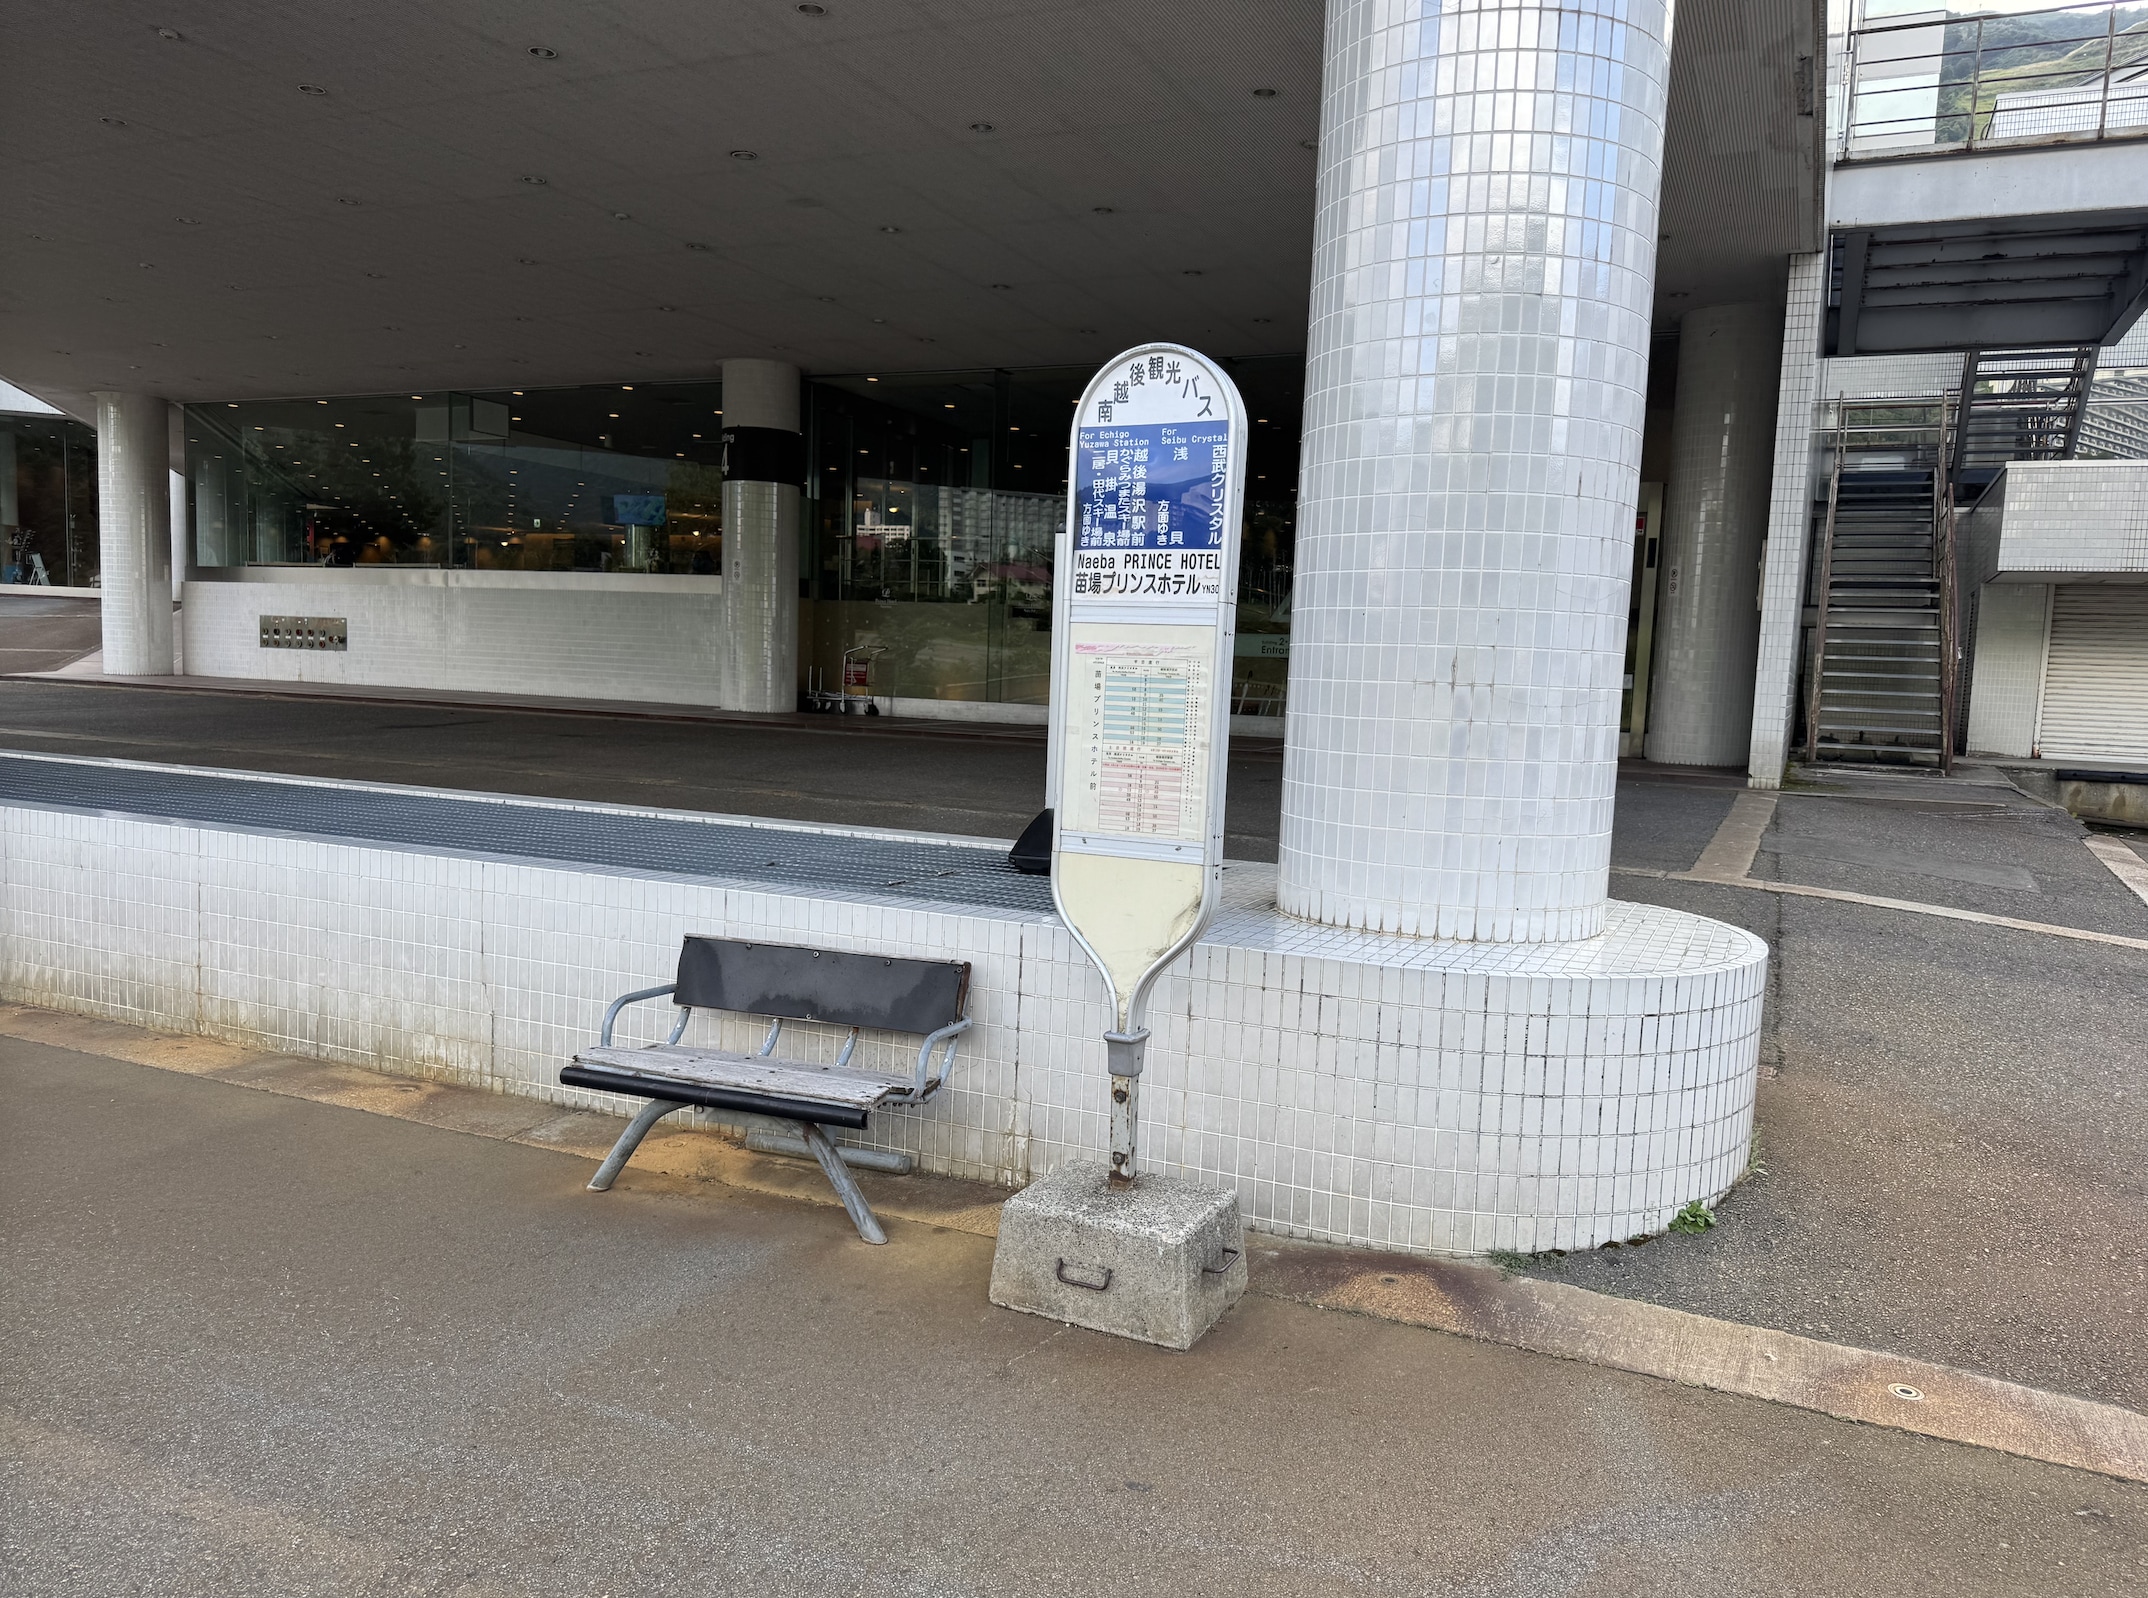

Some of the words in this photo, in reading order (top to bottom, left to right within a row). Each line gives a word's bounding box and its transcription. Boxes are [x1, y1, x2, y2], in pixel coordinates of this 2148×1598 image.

[1098, 356, 1213, 423] 南越後観光バス
[1079, 432, 1095, 440] For
[1099, 430, 1130, 439] Echigo
[1079, 440, 1110, 449] Yuzawa
[1113, 438, 1149, 447] Station
[1161, 428, 1177, 436] For
[1161, 436, 1187, 445] Seibu
[1191, 433, 1228, 444] Crystal
[1117, 448, 1134, 547] かぐらみつまたスキー場前
[1131, 448, 1149, 547] 越後湯沢駅前
[1208, 444, 1228, 545] 西武クリスタル
[1080, 503, 1092, 547] 方面ゆき
[1156, 500, 1170, 546] 方面ゆき
[1077, 553, 1115, 569] Naeba
[1124, 553, 1172, 569] PRINCE
[1181, 553, 1220, 570] HOTEL
[1075, 571, 1201, 595] 苗場プリンスホテル
